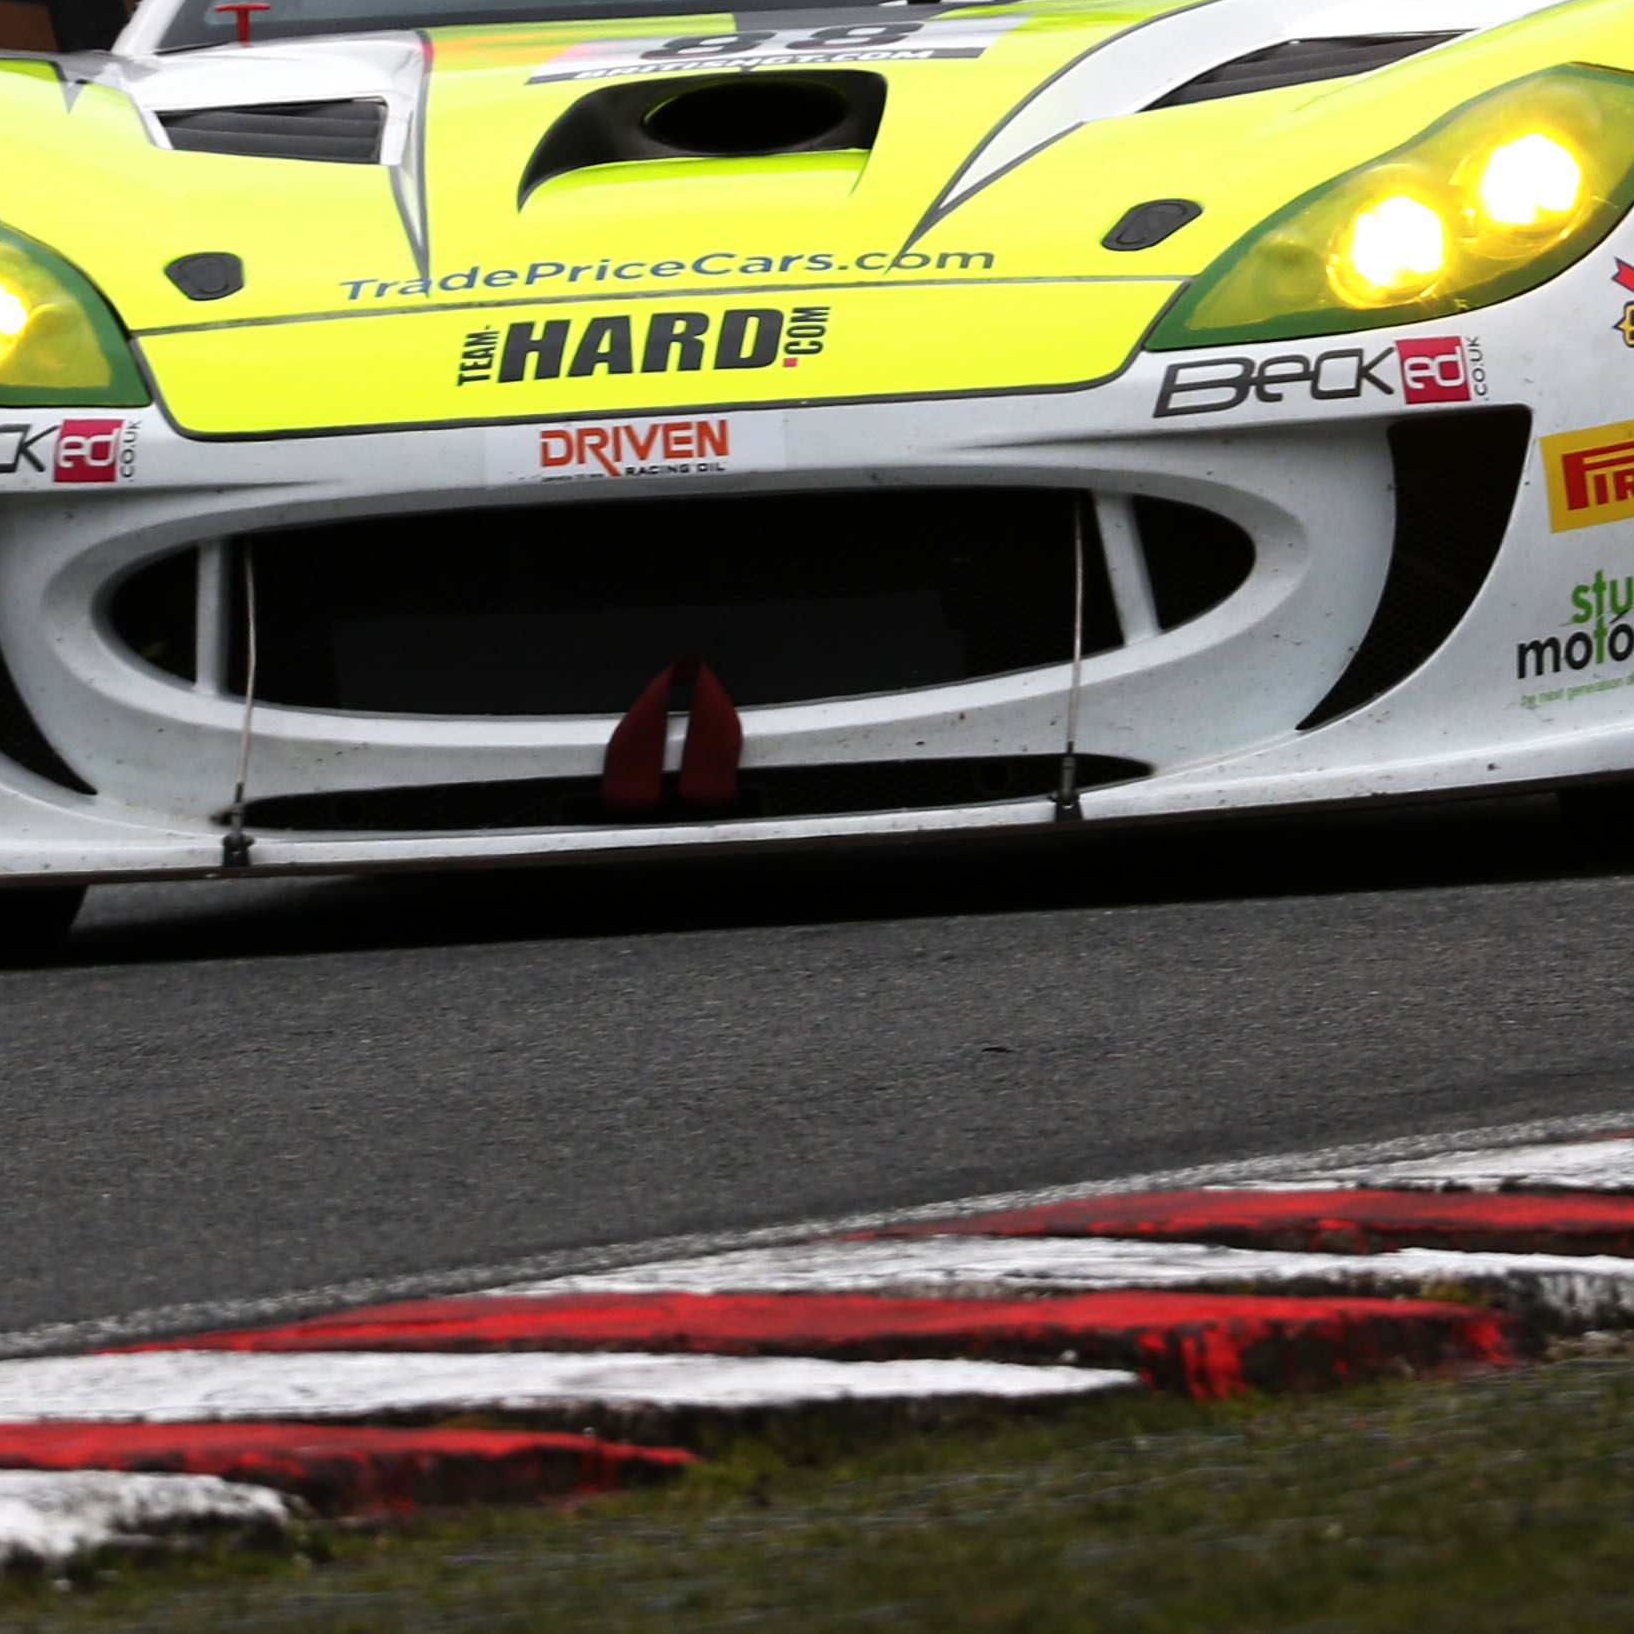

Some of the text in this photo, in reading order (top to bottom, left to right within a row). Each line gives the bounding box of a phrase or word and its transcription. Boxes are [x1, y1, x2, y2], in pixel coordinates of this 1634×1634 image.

[640, 21, 926, 61] 88
[573, 50, 936, 80] BRITISHGT.COM
[340, 249, 996, 302] TradePriceCars.com
[496, 307, 785, 384] HARD
[539, 419, 730, 477] DRIVEN
[624, 462, 727, 477] RACING OIL
